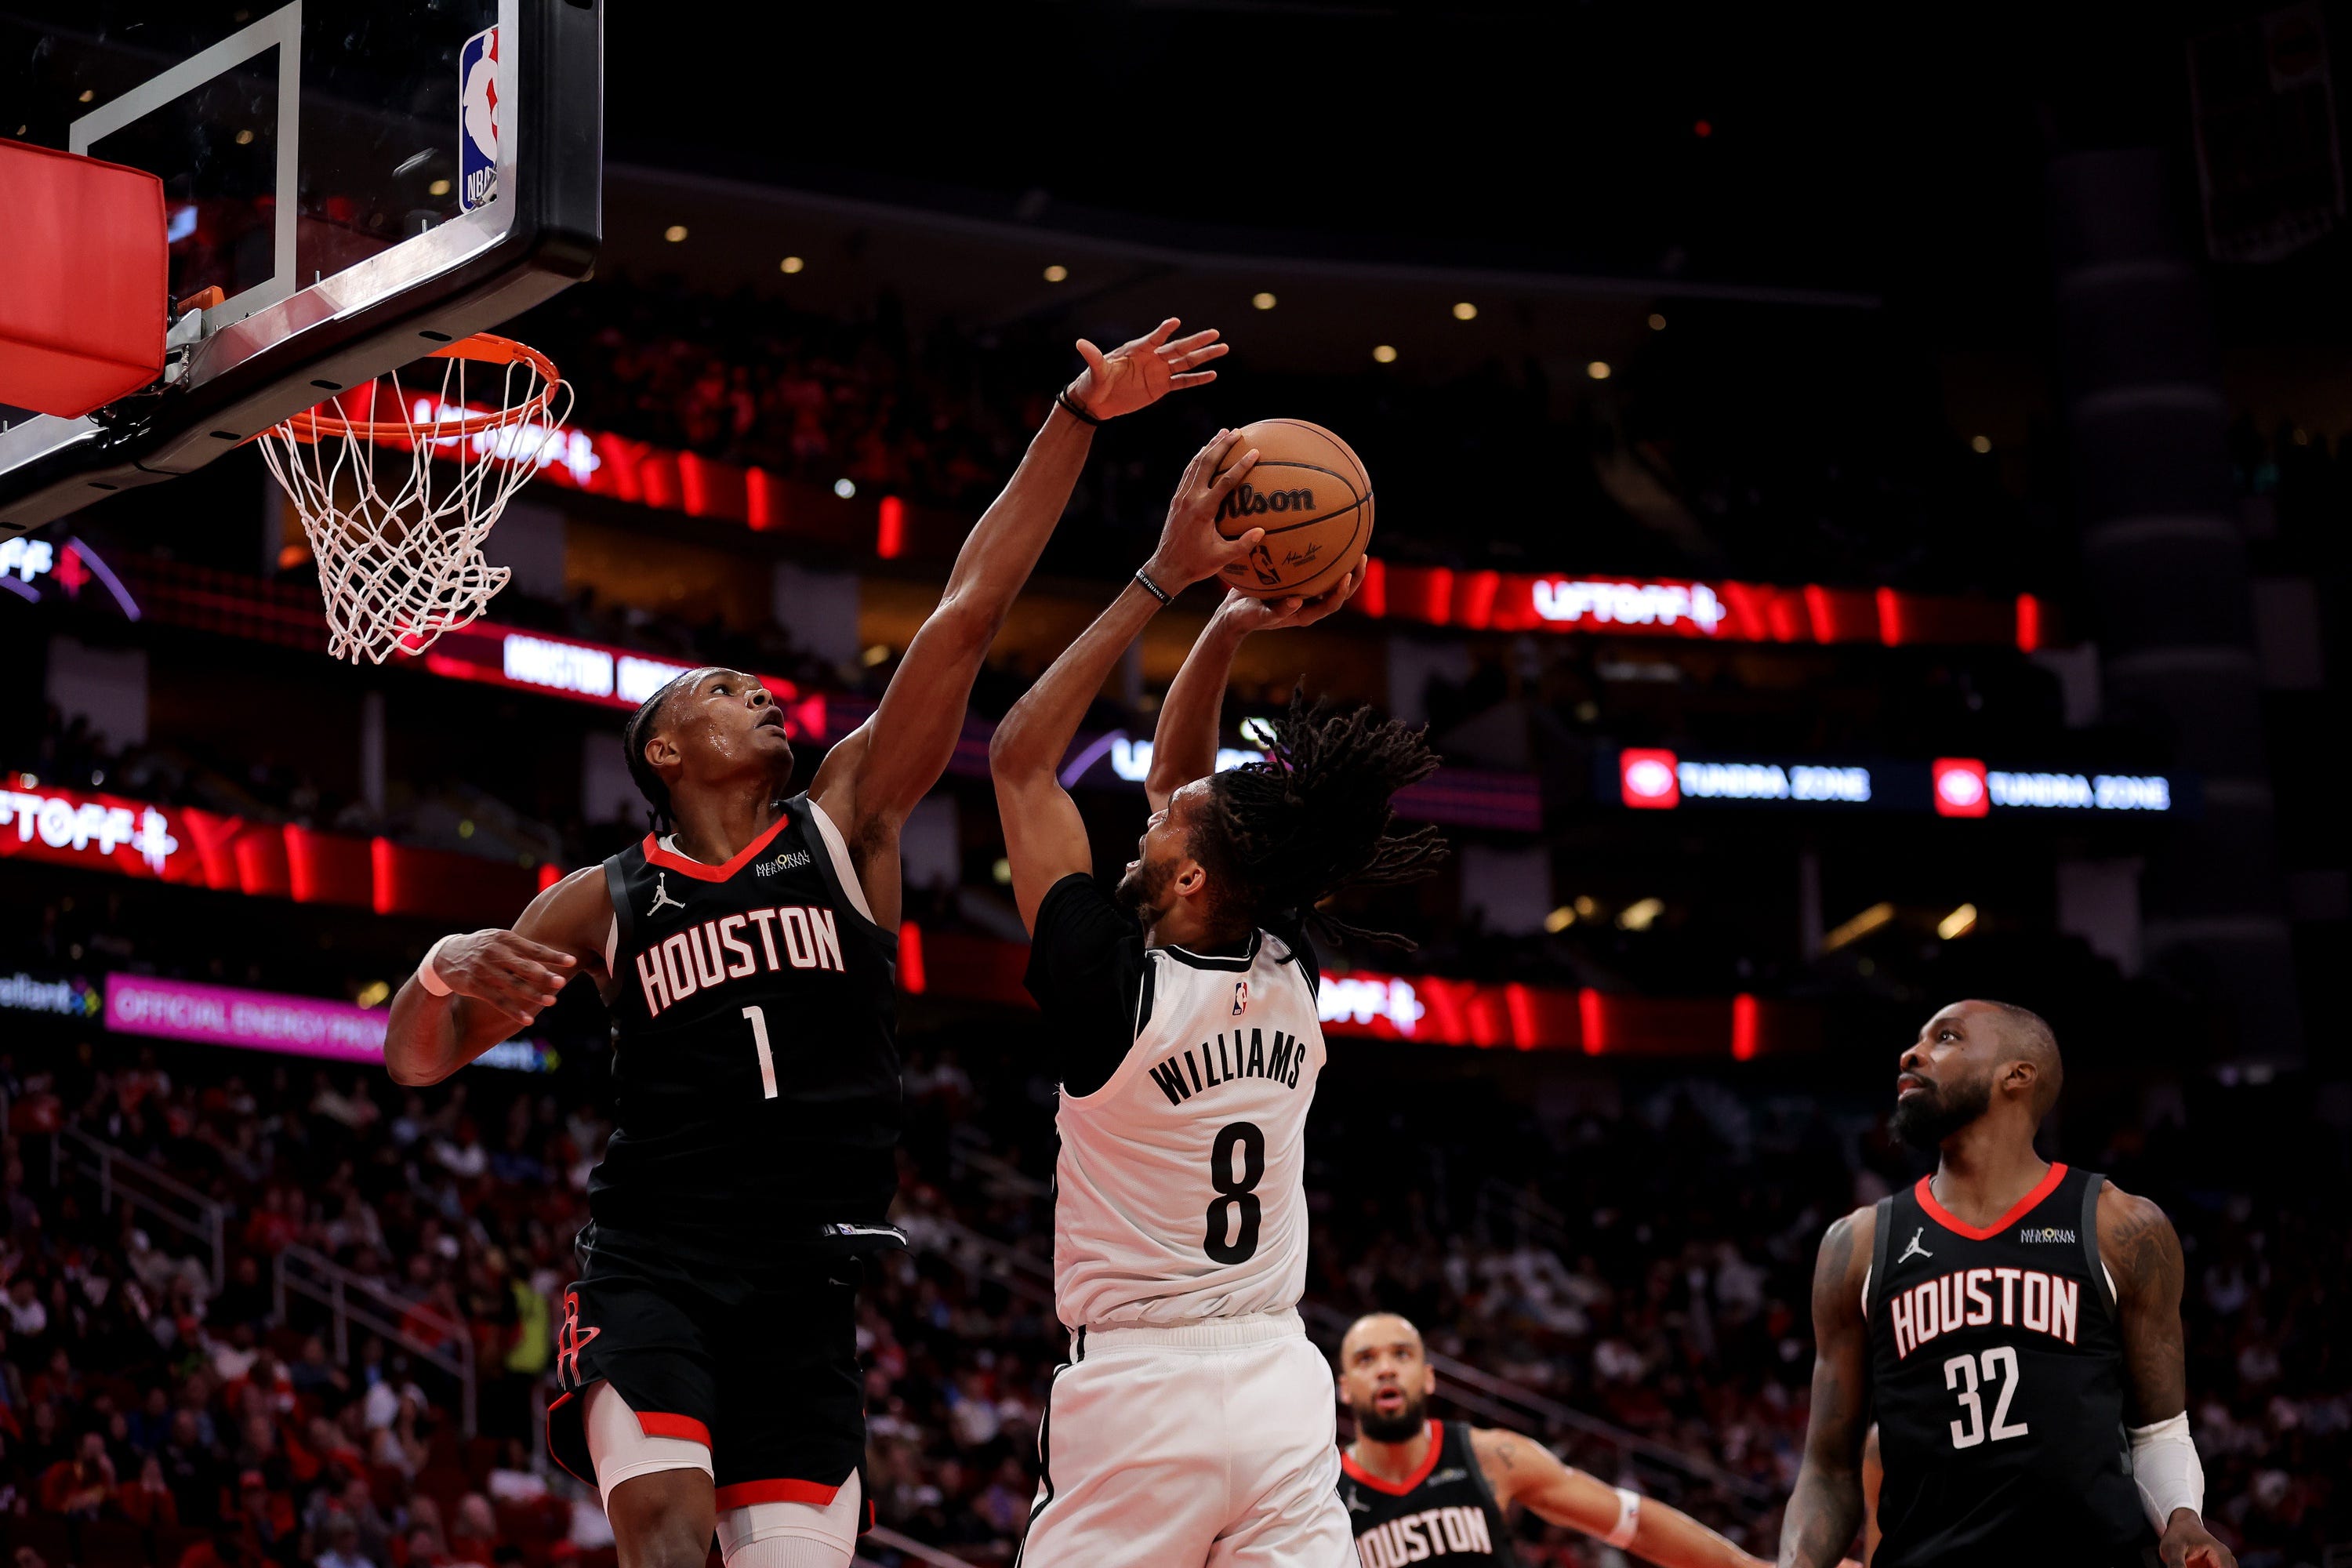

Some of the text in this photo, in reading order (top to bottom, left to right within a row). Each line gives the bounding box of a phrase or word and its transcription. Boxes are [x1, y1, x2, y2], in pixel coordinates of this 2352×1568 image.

[637, 906, 846, 1018] HOUSTON
[742, 1005, 778, 1099] 1
[1149, 1028, 1305, 1106] WILLIAMS
[1203, 1121, 1265, 1265] 8
[1891, 1267, 2080, 1361] HOUSTON
[1944, 1345, 2029, 1449] 32
